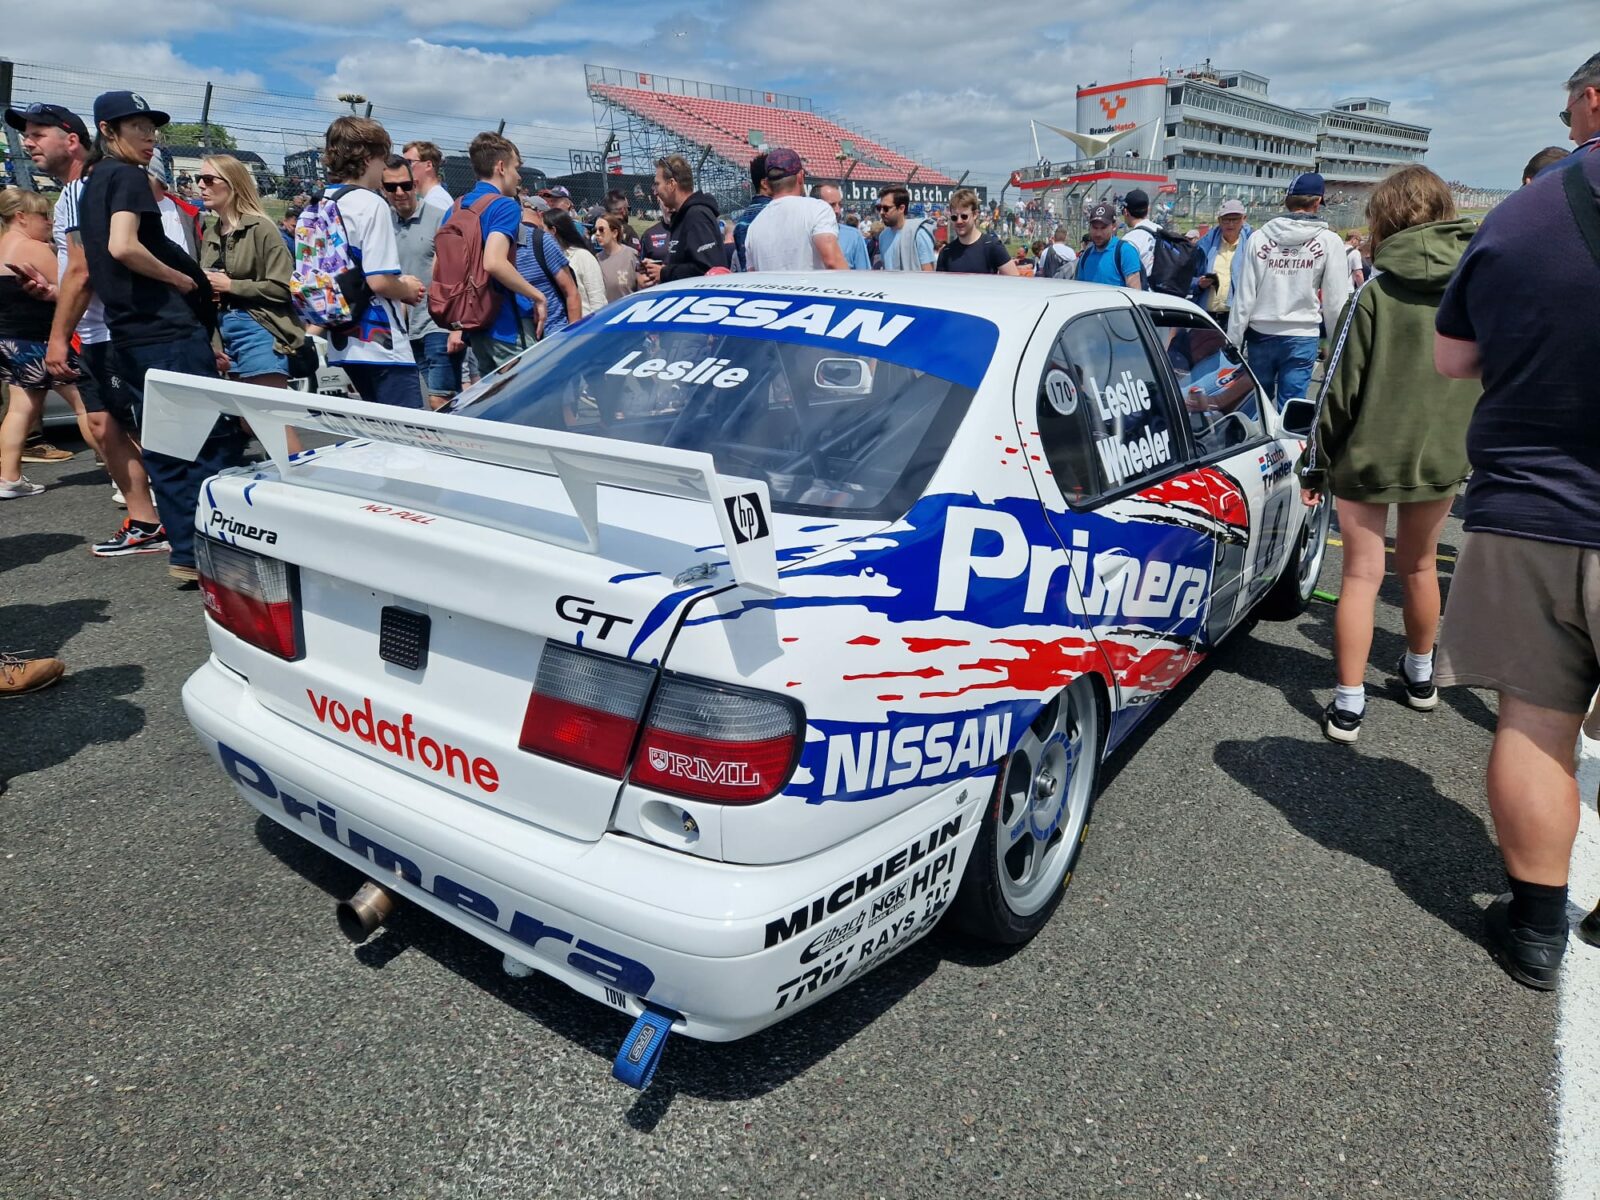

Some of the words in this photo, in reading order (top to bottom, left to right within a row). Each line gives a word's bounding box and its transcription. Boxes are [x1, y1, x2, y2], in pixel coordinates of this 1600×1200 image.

[1089, 121, 1137, 135] BrandsHatch
[1292, 259, 1314, 269] TEAM
[693, 282, 889, 300] www.nissan.co.uk
[604, 296, 915, 347] NISSAN
[604, 350, 750, 388] Leslie
[1050, 381, 1073, 404] 170
[1089, 370, 1152, 421] Leslie
[1096, 425, 1171, 486] Wheeler
[1261, 459, 1293, 488] Trader
[1265, 447, 1285, 468] Auto
[210, 509, 278, 545] Primera
[360, 503, 390, 514] NO
[391, 509, 437, 525] PULL
[933, 505, 1208, 618] Primera
[555, 594, 634, 641] GT
[305, 688, 500, 793] vodafone
[822, 712, 1013, 797] NISSAN
[668, 751, 760, 786] RML
[217, 740, 656, 998] Primera
[763, 814, 964, 949] MICHELIN
[909, 846, 957, 901] HPI
[872, 881, 907, 918] NGK
[800, 909, 867, 965] Eibach
[859, 911, 916, 961] RAYS
[604, 986, 627, 1009] TOW
[774, 944, 855, 1011] TRW
